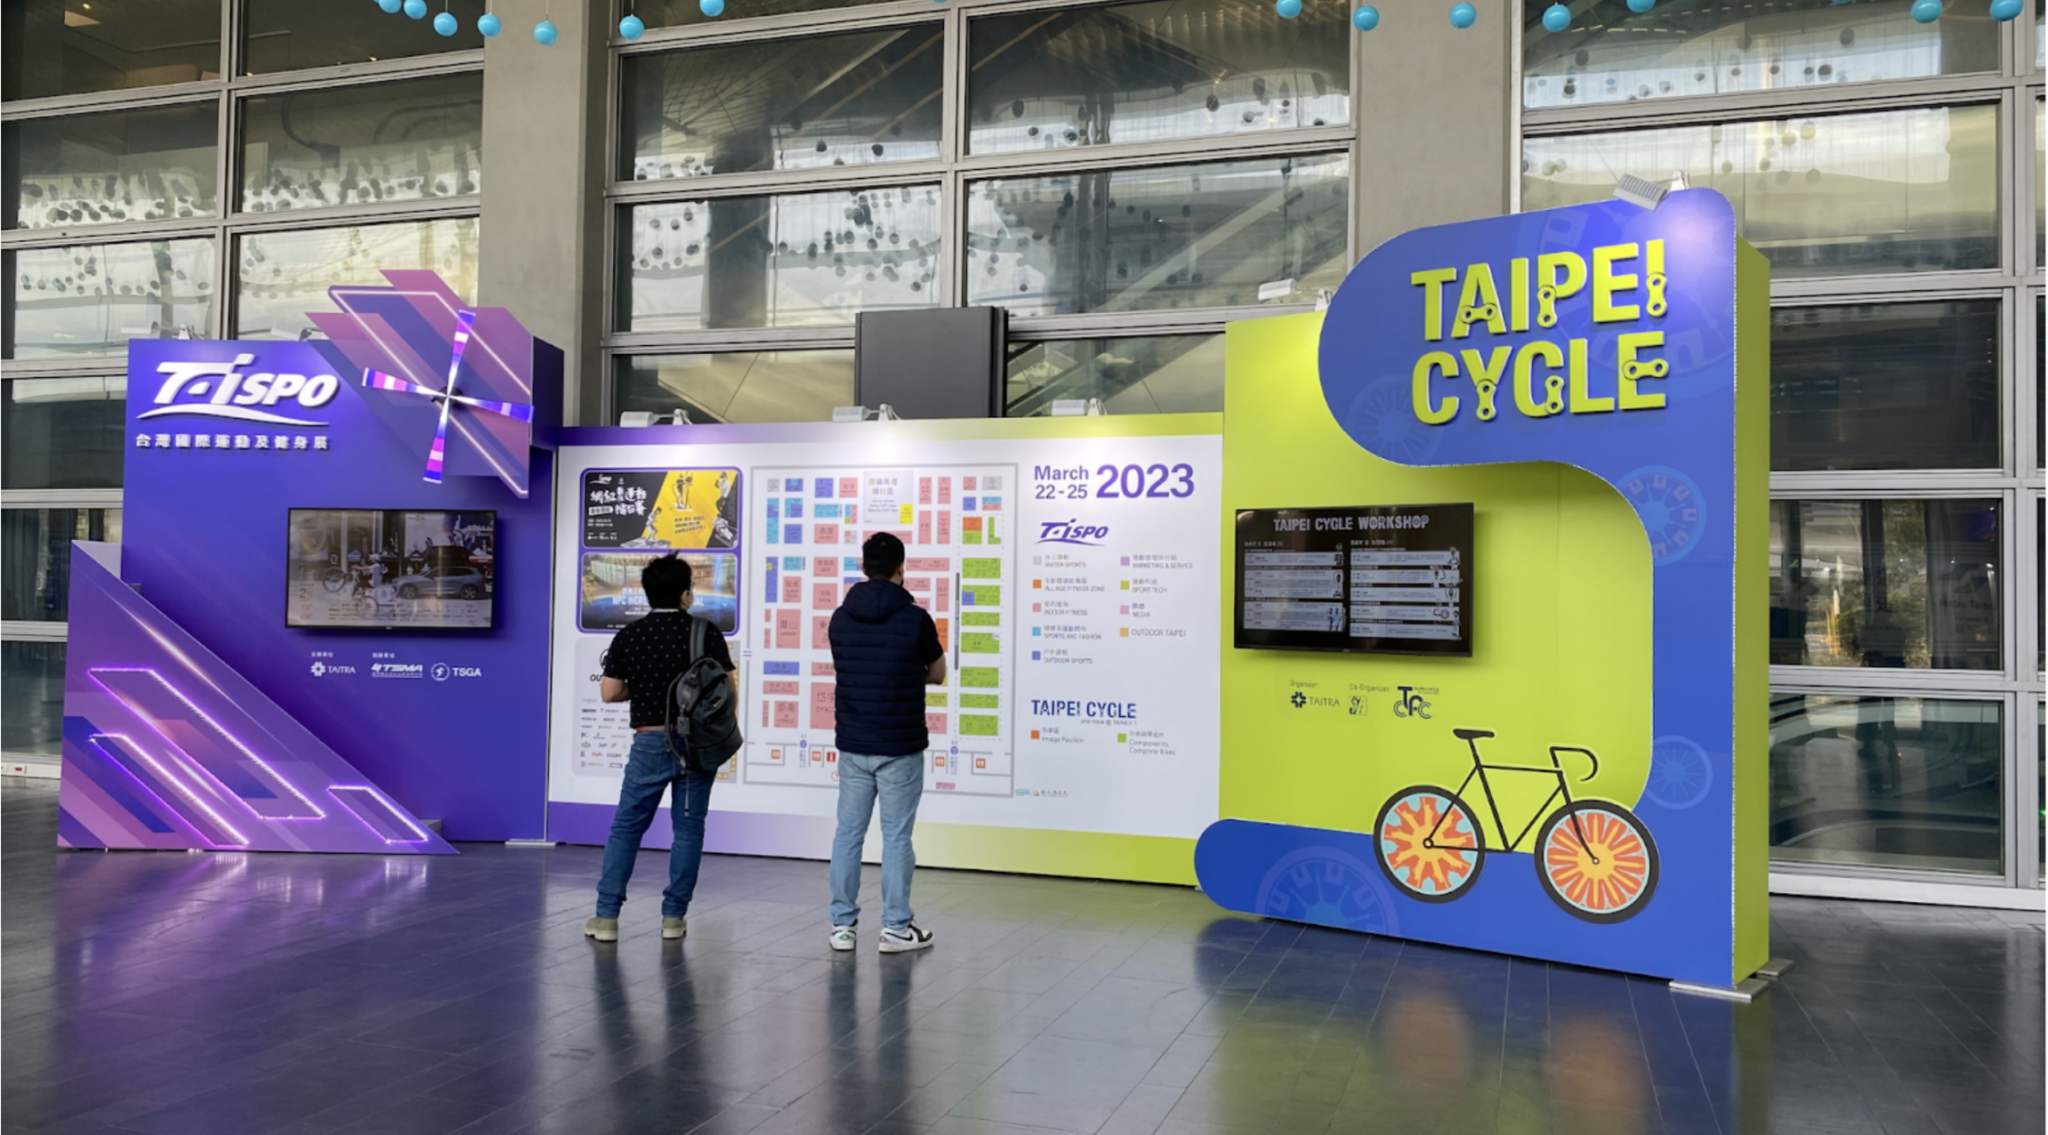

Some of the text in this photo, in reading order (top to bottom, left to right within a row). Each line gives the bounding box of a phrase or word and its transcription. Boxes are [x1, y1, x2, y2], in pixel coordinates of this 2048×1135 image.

[1411, 239, 1667, 341] TAIPEI
[1412, 331, 1668, 425] CYCLE
[136, 433, 330, 450] 台灣國際運動及健身展
[1034, 463, 1194, 498] March 2023
[1274, 514, 1429, 532] TAIPEI CYCLE WORKSHOP
[1165, 629, 1186, 637] TAIPEI
[327, 665, 356, 674] TAITRA
[452, 667, 482, 677] TSGA
[1031, 699, 1137, 719] TAIPEI CYCLE
[1310, 697, 1340, 707] TAITRA
